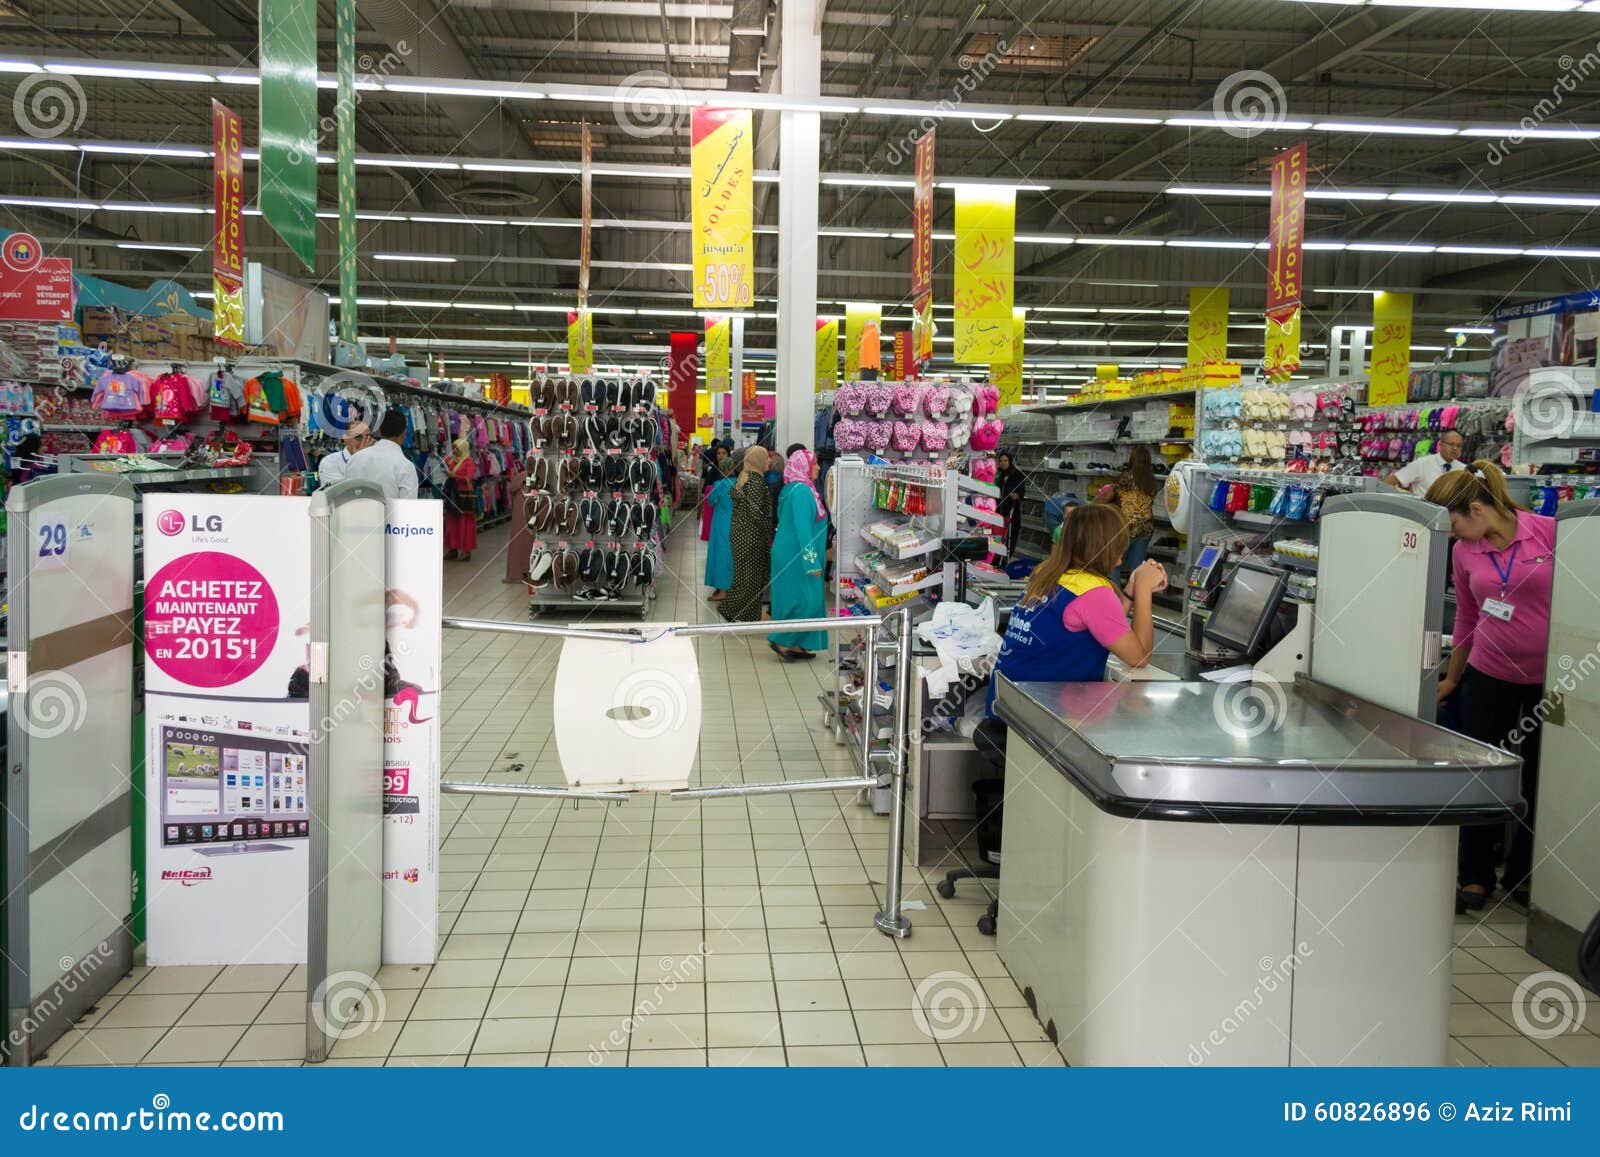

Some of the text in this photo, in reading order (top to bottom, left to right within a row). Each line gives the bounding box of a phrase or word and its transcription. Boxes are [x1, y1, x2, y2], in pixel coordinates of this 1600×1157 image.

[229, 117, 241, 271] promotion
[702, 168, 744, 235] SOLDES
[922, 136, 933, 284] promotion
[1285, 151, 1301, 298] promotion
[697, 263, 750, 304] -50%
[1496, 305, 1522, 319] LINGE
[1523, 303, 1536, 314] DE
[191, 514, 223, 532] LG
[39, 523, 67, 557] 29
[1403, 531, 1417, 549] 30
[159, 580, 263, 599] ACHETEZ
[156, 601, 258, 615] MAINTENANT
[173, 616, 241, 635] PAYEZ
[156, 648, 172, 659] EN
